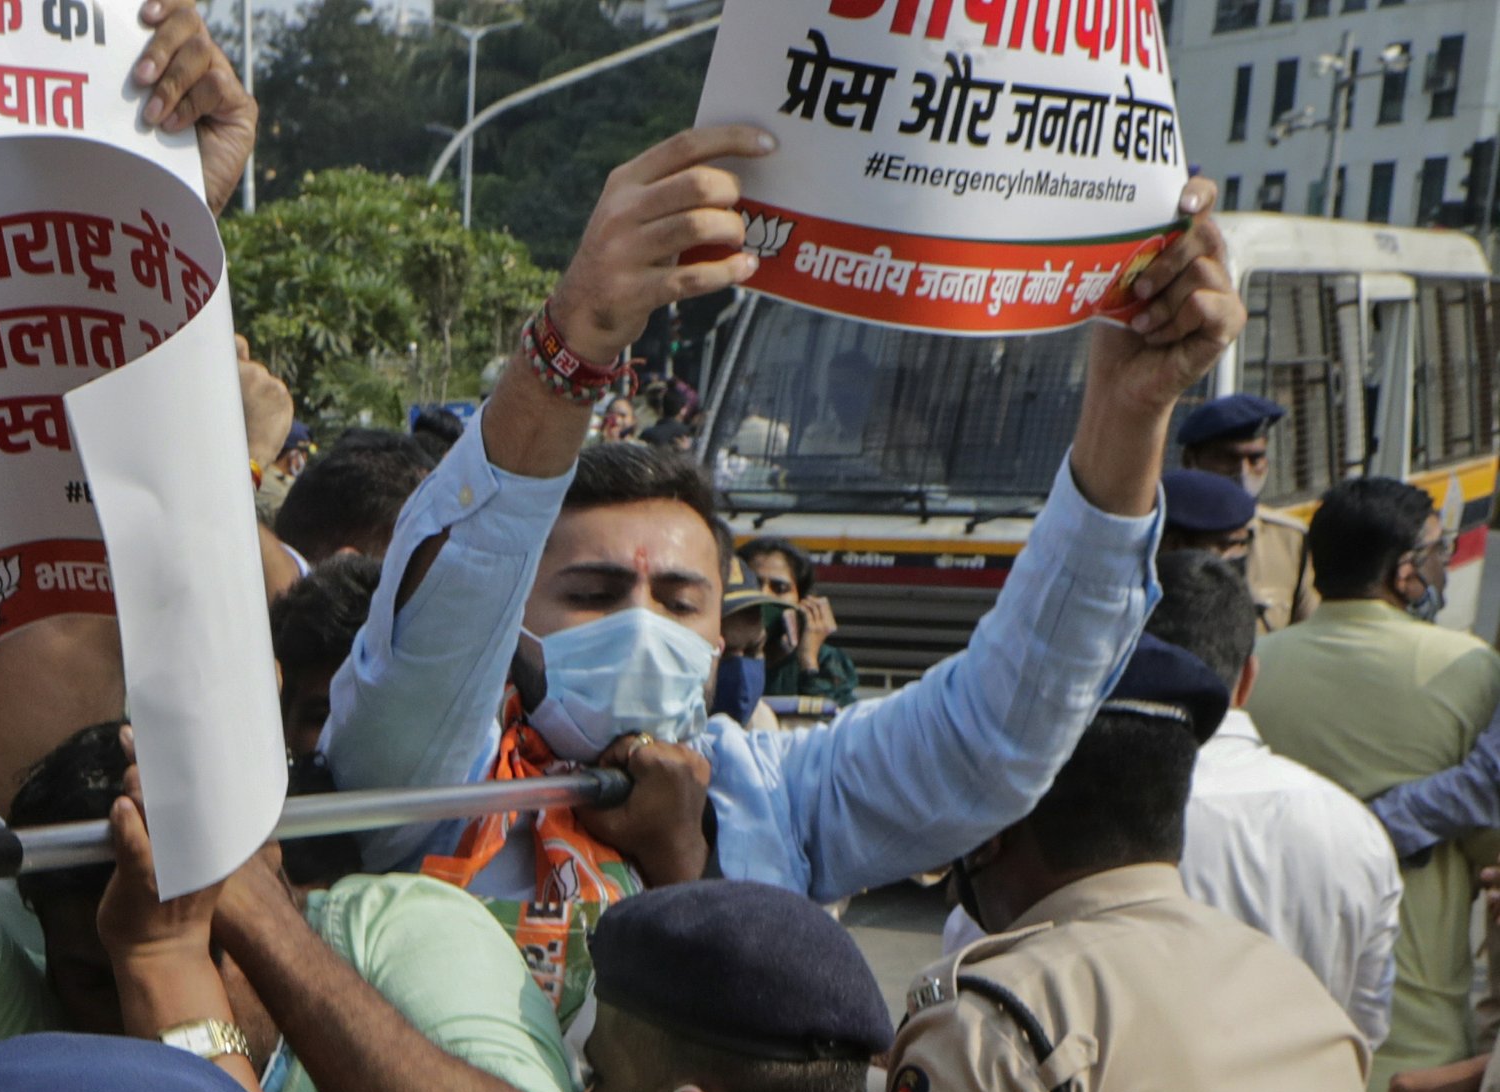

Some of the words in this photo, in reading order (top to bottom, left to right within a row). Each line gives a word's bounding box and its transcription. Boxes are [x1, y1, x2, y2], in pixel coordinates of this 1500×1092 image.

[779, 29, 896, 133] प्रेस
[898, 51, 1003, 147] और
[1006, 83, 1109, 158] जनता
[1113, 74, 1178, 167] बेहाल
[863, 151, 1137, 202] #EmergencyInMaharashtra
[121, 208, 172, 304] में
[794, 242, 915, 297] भारतीय
[915, 263, 990, 304] जनता
[987, 268, 1025, 316] युवा
[1023, 260, 1074, 305] मोर्चा
[1070, 261, 1120, 315] मुंबई
